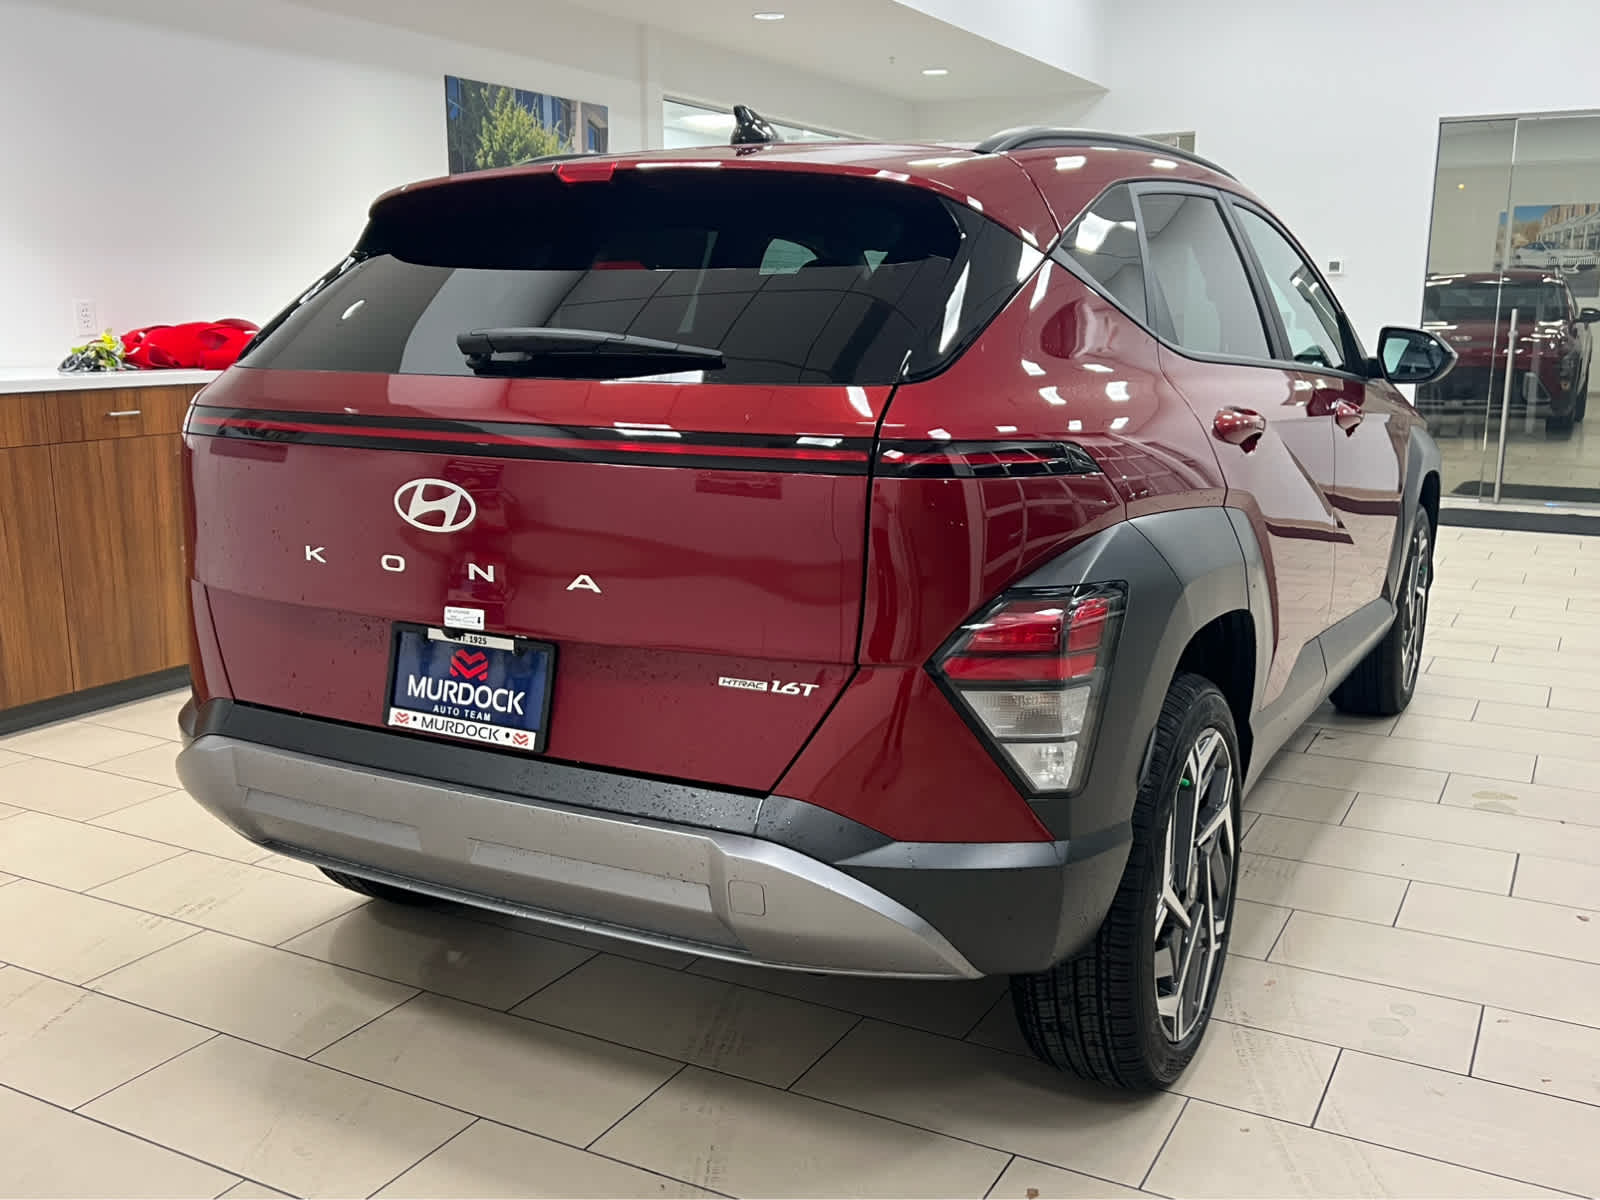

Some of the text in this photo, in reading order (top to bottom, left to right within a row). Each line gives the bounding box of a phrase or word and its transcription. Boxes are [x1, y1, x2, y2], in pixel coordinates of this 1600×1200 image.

[305, 545, 602, 593] KONA
[469, 635, 487, 645] 1925
[721, 678, 765, 690] HTRAC
[407, 674, 526, 715] MURDOCK
[433, 705, 491, 721] AUTO TEAM
[420, 716, 500, 741] MURDOCK
